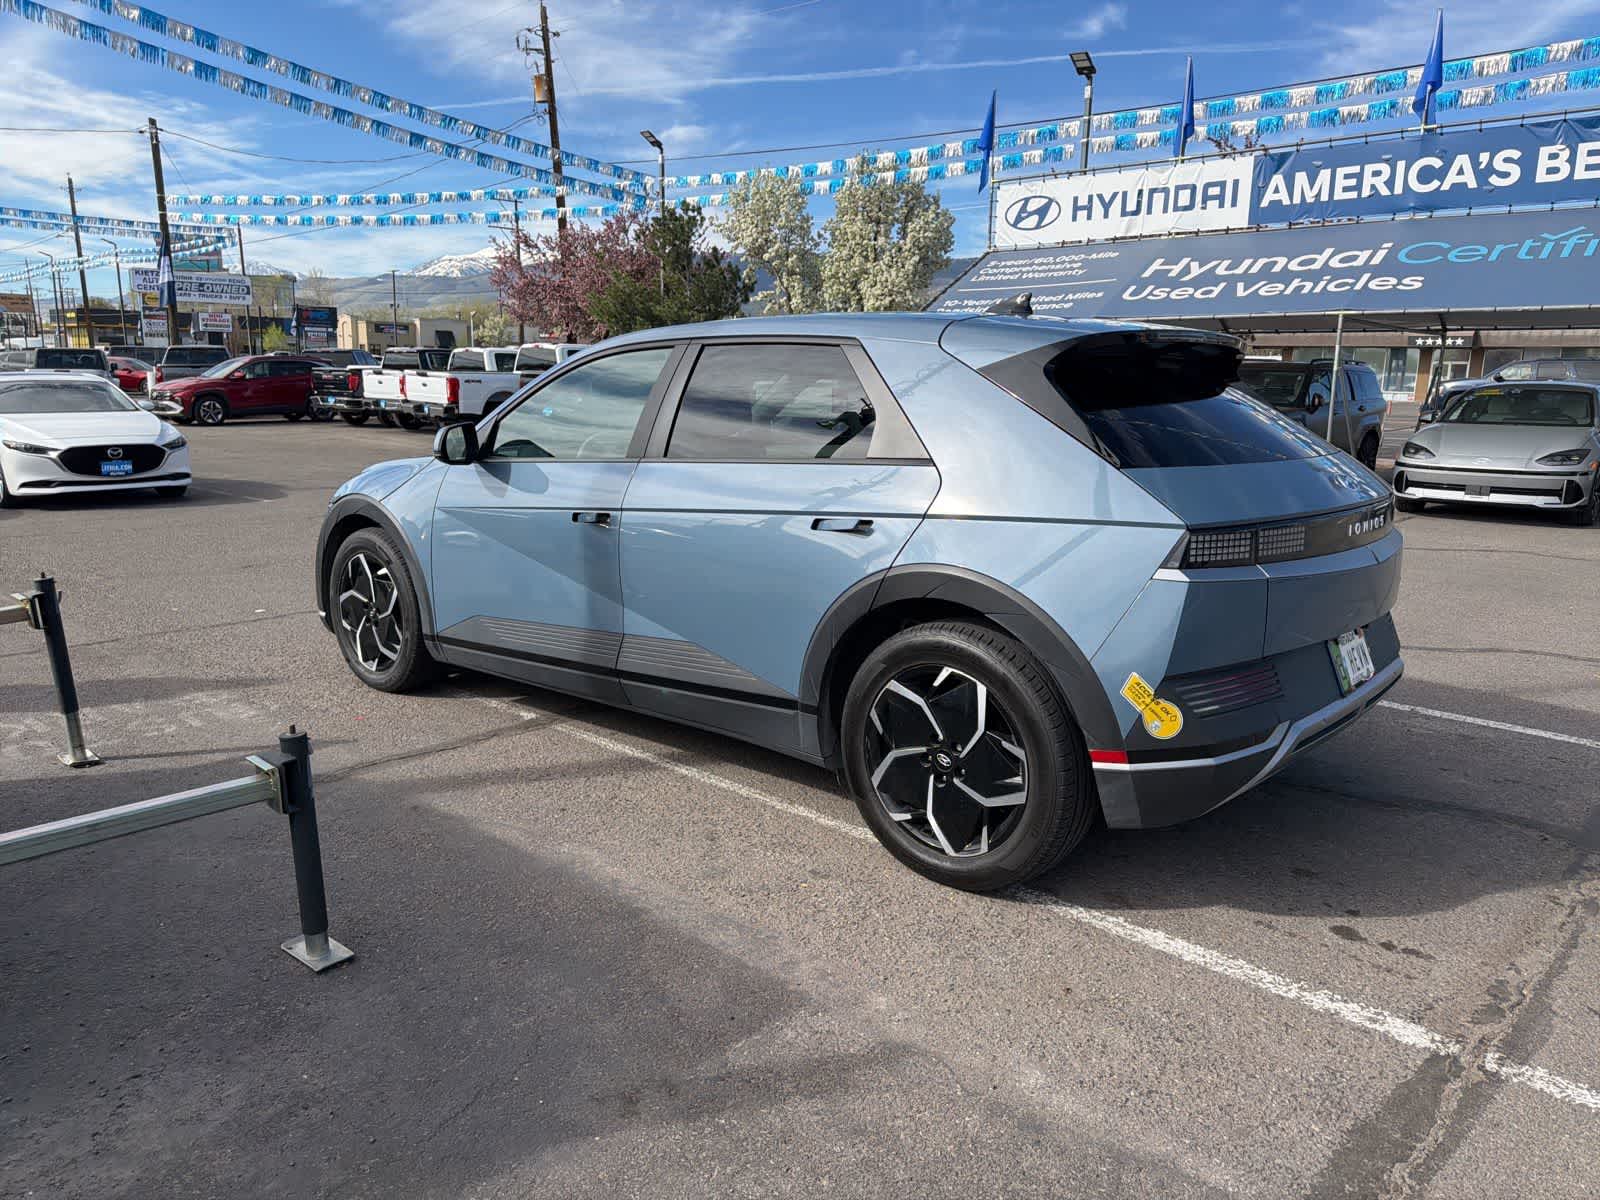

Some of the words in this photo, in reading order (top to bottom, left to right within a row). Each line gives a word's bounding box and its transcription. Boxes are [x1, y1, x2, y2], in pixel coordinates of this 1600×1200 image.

[1260, 149, 1523, 208] AMERICA'S
[1072, 179, 1240, 222] HYUNDAI
[979, 261, 1082, 275] Comprehensive
[1140, 242, 1395, 281] Hyundai
[135, 268, 160, 277] KIETZ
[969, 271, 1020, 282] Limited
[1022, 268, 1088, 279] Warranty
[136, 283, 160, 291] CENT
[175, 281, 248, 295] PRE-OWNED
[1121, 281, 1227, 301] Used
[1234, 272, 1426, 298] Vehicles
